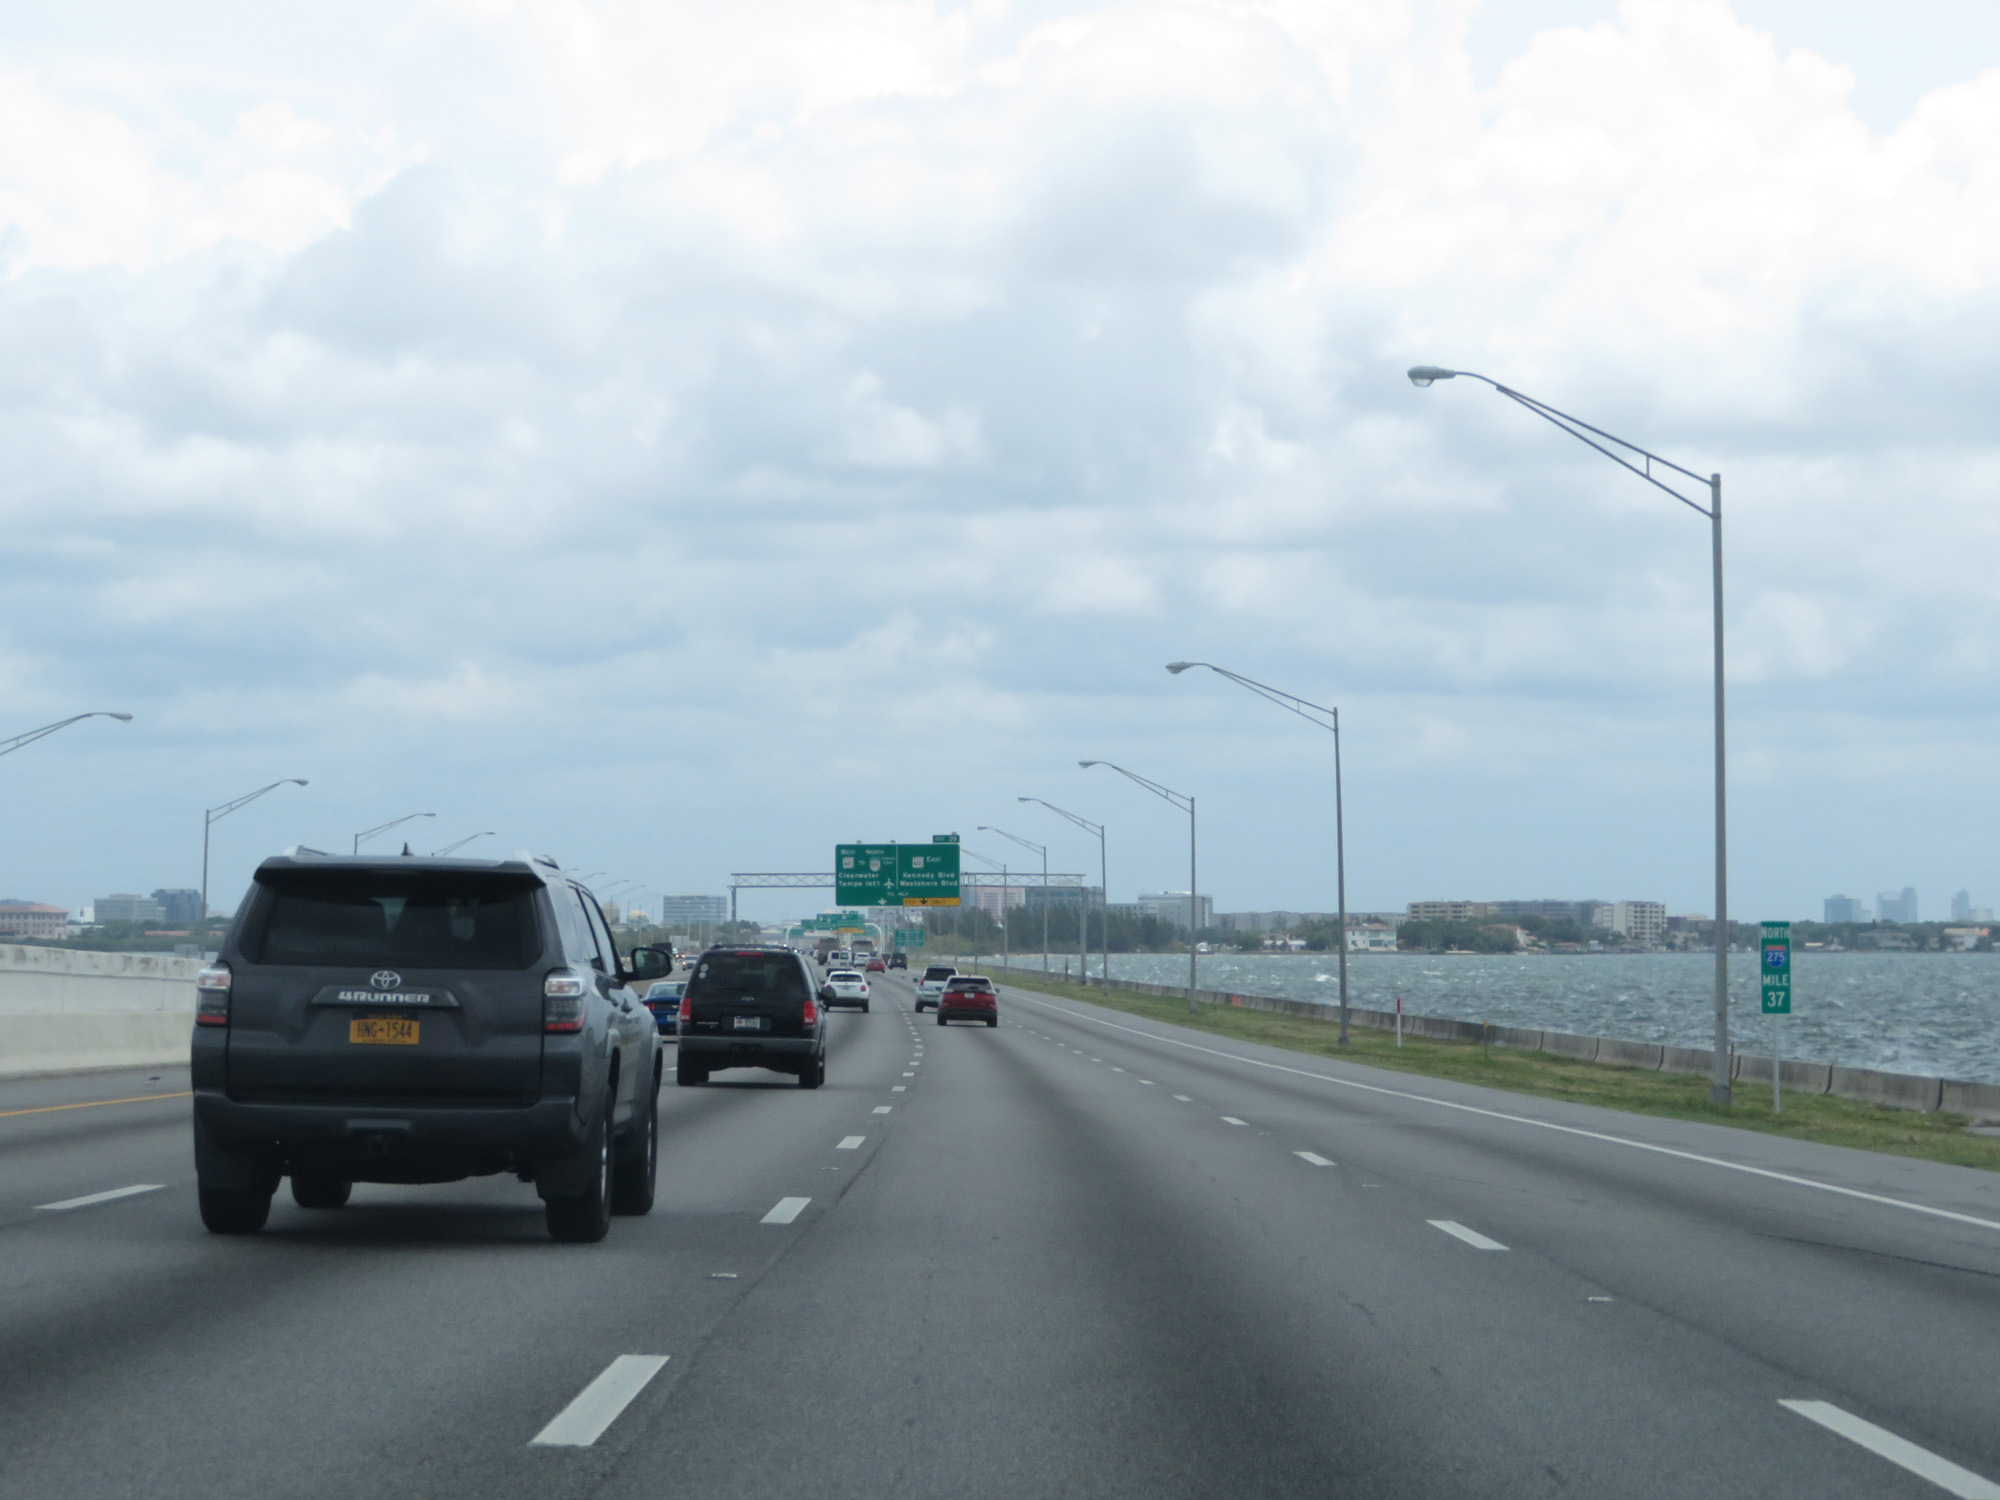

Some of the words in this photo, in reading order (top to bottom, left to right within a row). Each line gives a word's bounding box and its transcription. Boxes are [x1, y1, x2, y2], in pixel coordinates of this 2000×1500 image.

[1761, 927, 1789, 939] NORTH
[1767, 951, 1785, 962] 275
[1763, 974, 1788, 986] MILE
[338, 990, 430, 1003] 4RUNNER
[1767, 991, 1785, 1007] 37
